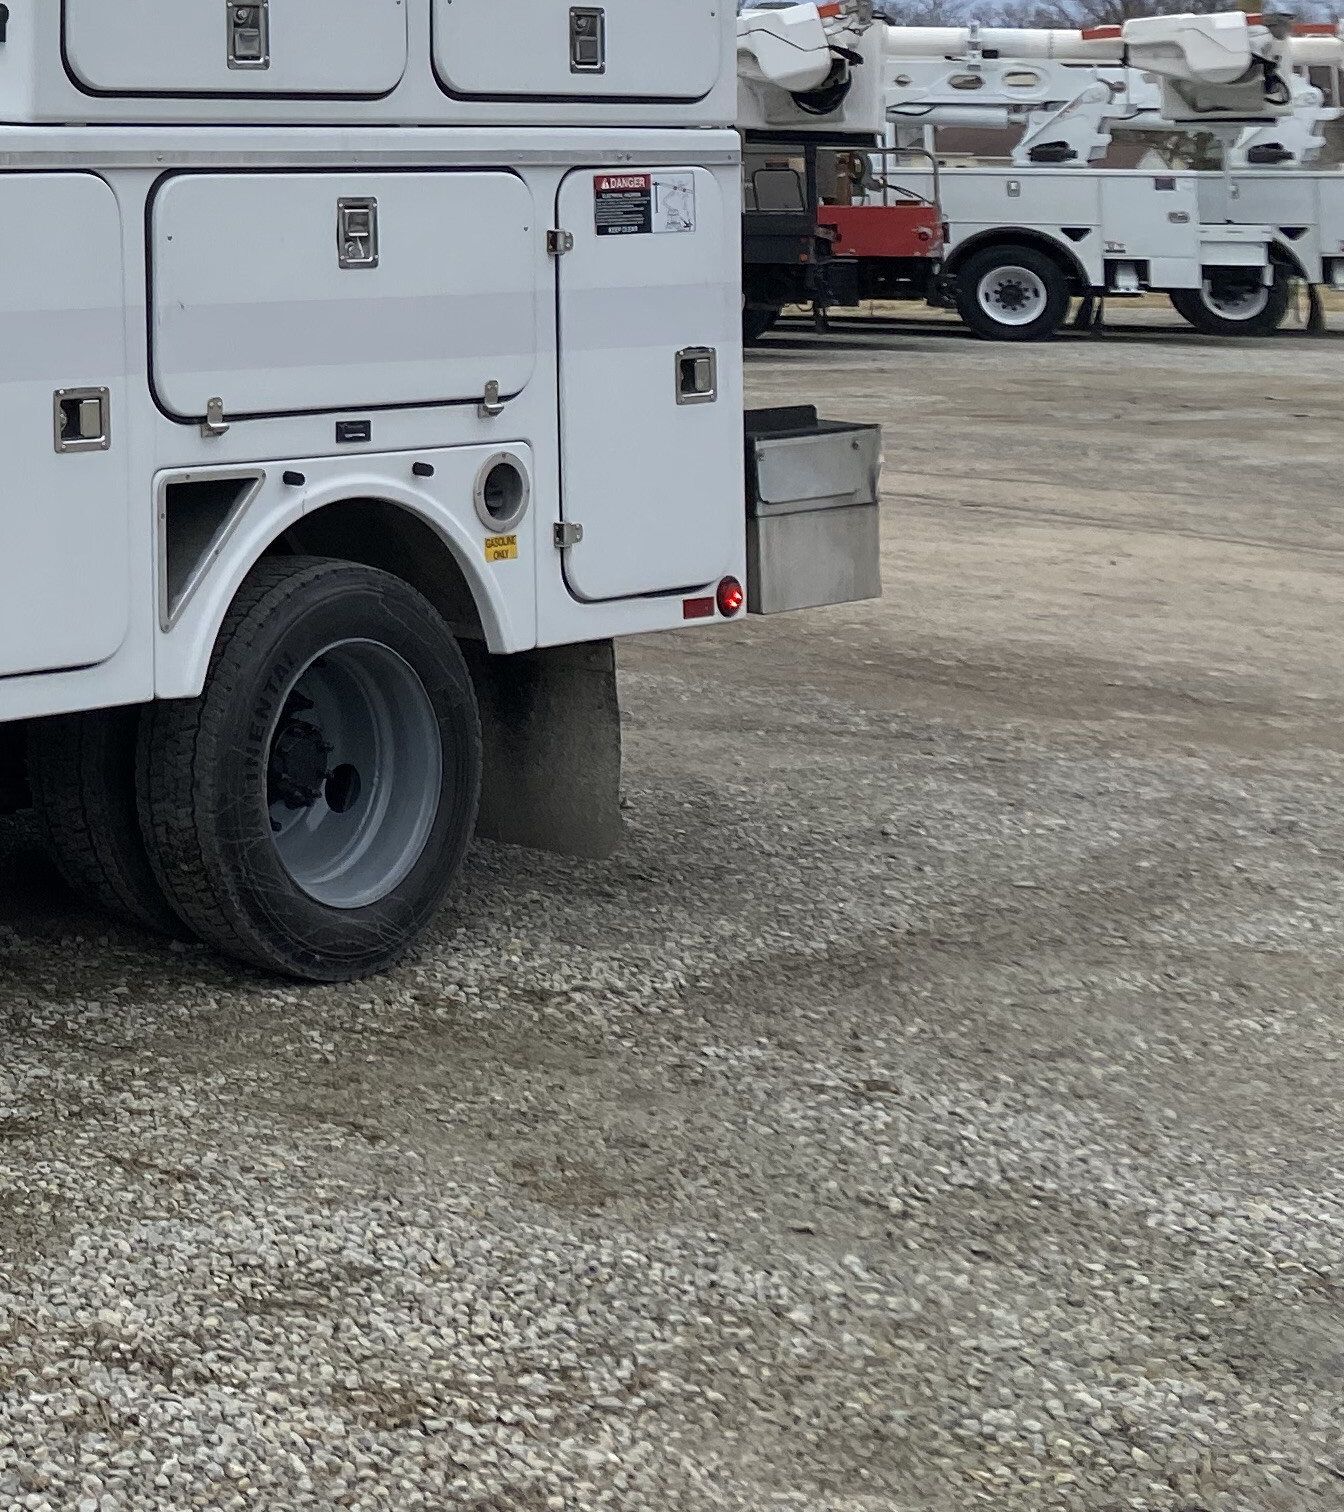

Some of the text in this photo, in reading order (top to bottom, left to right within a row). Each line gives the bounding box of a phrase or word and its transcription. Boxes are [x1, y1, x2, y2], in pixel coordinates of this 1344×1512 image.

[610, 177, 645, 188] DANGER
[486, 536, 516, 548] GASOLINE
[494, 549, 509, 560] ONLY
